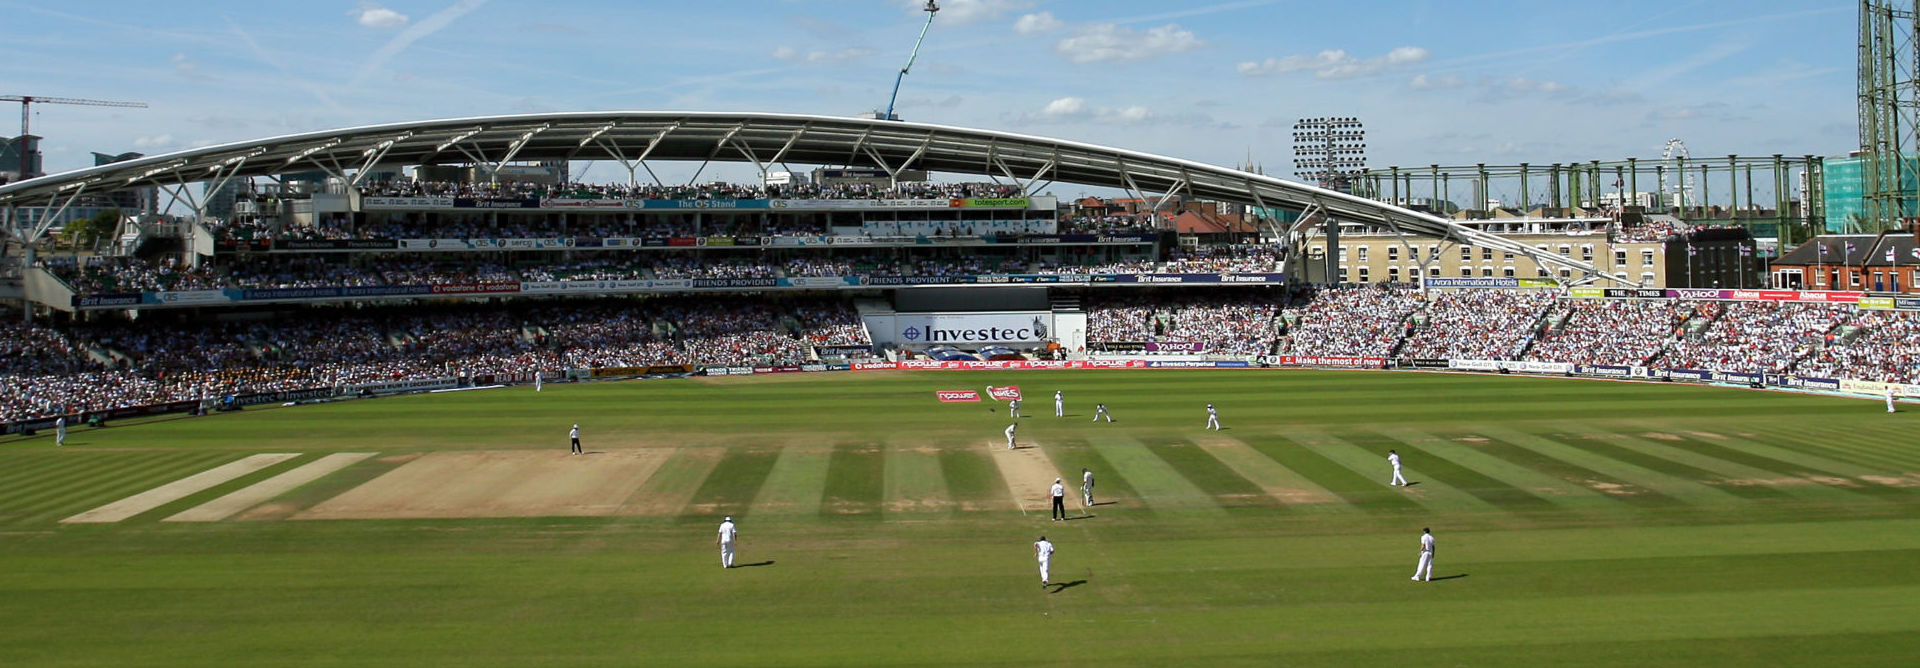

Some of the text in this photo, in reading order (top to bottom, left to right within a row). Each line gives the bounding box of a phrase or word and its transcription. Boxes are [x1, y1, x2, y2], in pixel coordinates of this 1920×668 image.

[475, 200, 522, 208] Brit Insurance
[678, 200, 692, 208] The
[711, 200, 736, 208] Stand
[974, 198, 1025, 207] totesport.com
[511, 240, 532, 248] serco
[693, 278, 777, 287] FRIENDS PROVIDENT
[905, 276, 951, 284] PROVIDENT
[1495, 279, 1518, 287] Hotels
[442, 283, 519, 292] vodafone vodafone
[1676, 289, 1719, 298] YAHOO!
[1799, 291, 1827, 299] Abacus
[81, 296, 137, 306] Brit Insurance
[925, 325, 1029, 342] Investec
[821, 347, 868, 355] Brit Insurance
[1157, 342, 1195, 351] YAHOO!
[902, 361, 943, 369] npower
[964, 361, 1006, 369] npower
[1025, 360, 1067, 368] npower
[1581, 366, 1627, 375] Brit Insurance
[1654, 369, 1701, 379] Brit Insurance
[1711, 372, 1726, 380] Brit
[1727, 374, 1760, 383] Insurane
[1787, 377, 1837, 388] Brit Insurance
[234, 388, 330, 405] nvestec Investec
